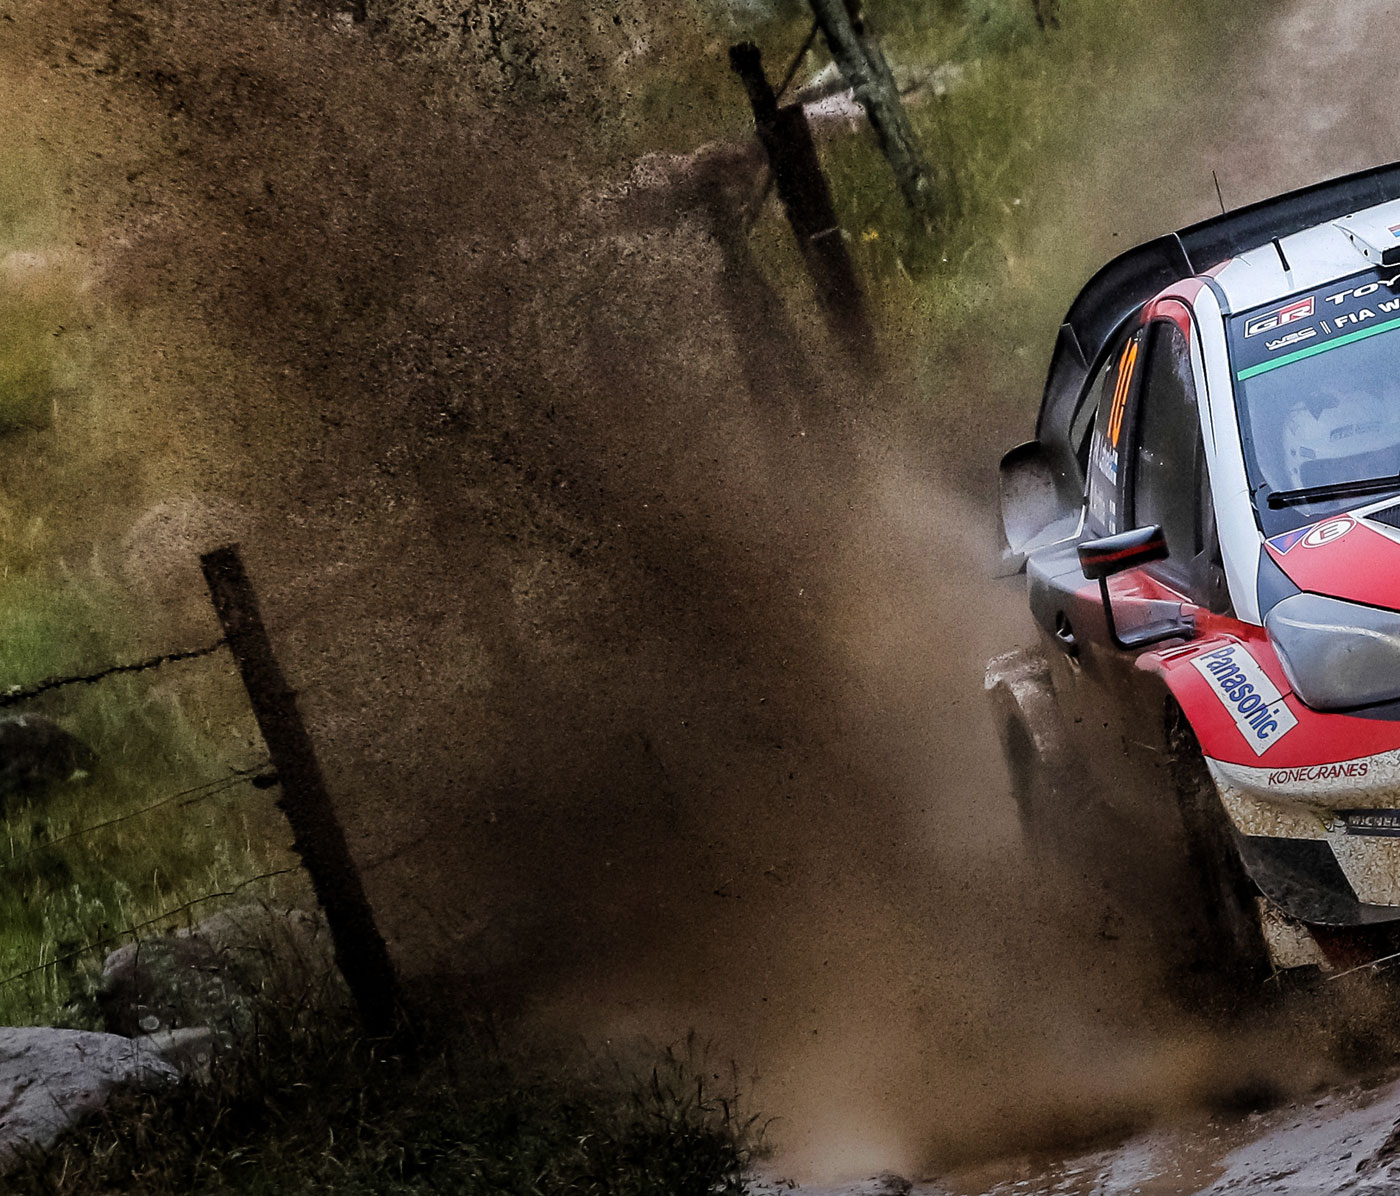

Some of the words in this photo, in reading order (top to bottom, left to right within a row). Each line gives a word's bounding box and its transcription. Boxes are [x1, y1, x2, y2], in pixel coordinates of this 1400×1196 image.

[1248, 303, 1312, 336] GR
[1333, 307, 1377, 329] FIA
[1107, 336, 1139, 449] 10
[1319, 523, 1340, 541] E
[1199, 646, 1280, 740] Panasonic
[1267, 762, 1369, 786] KONECRANES
